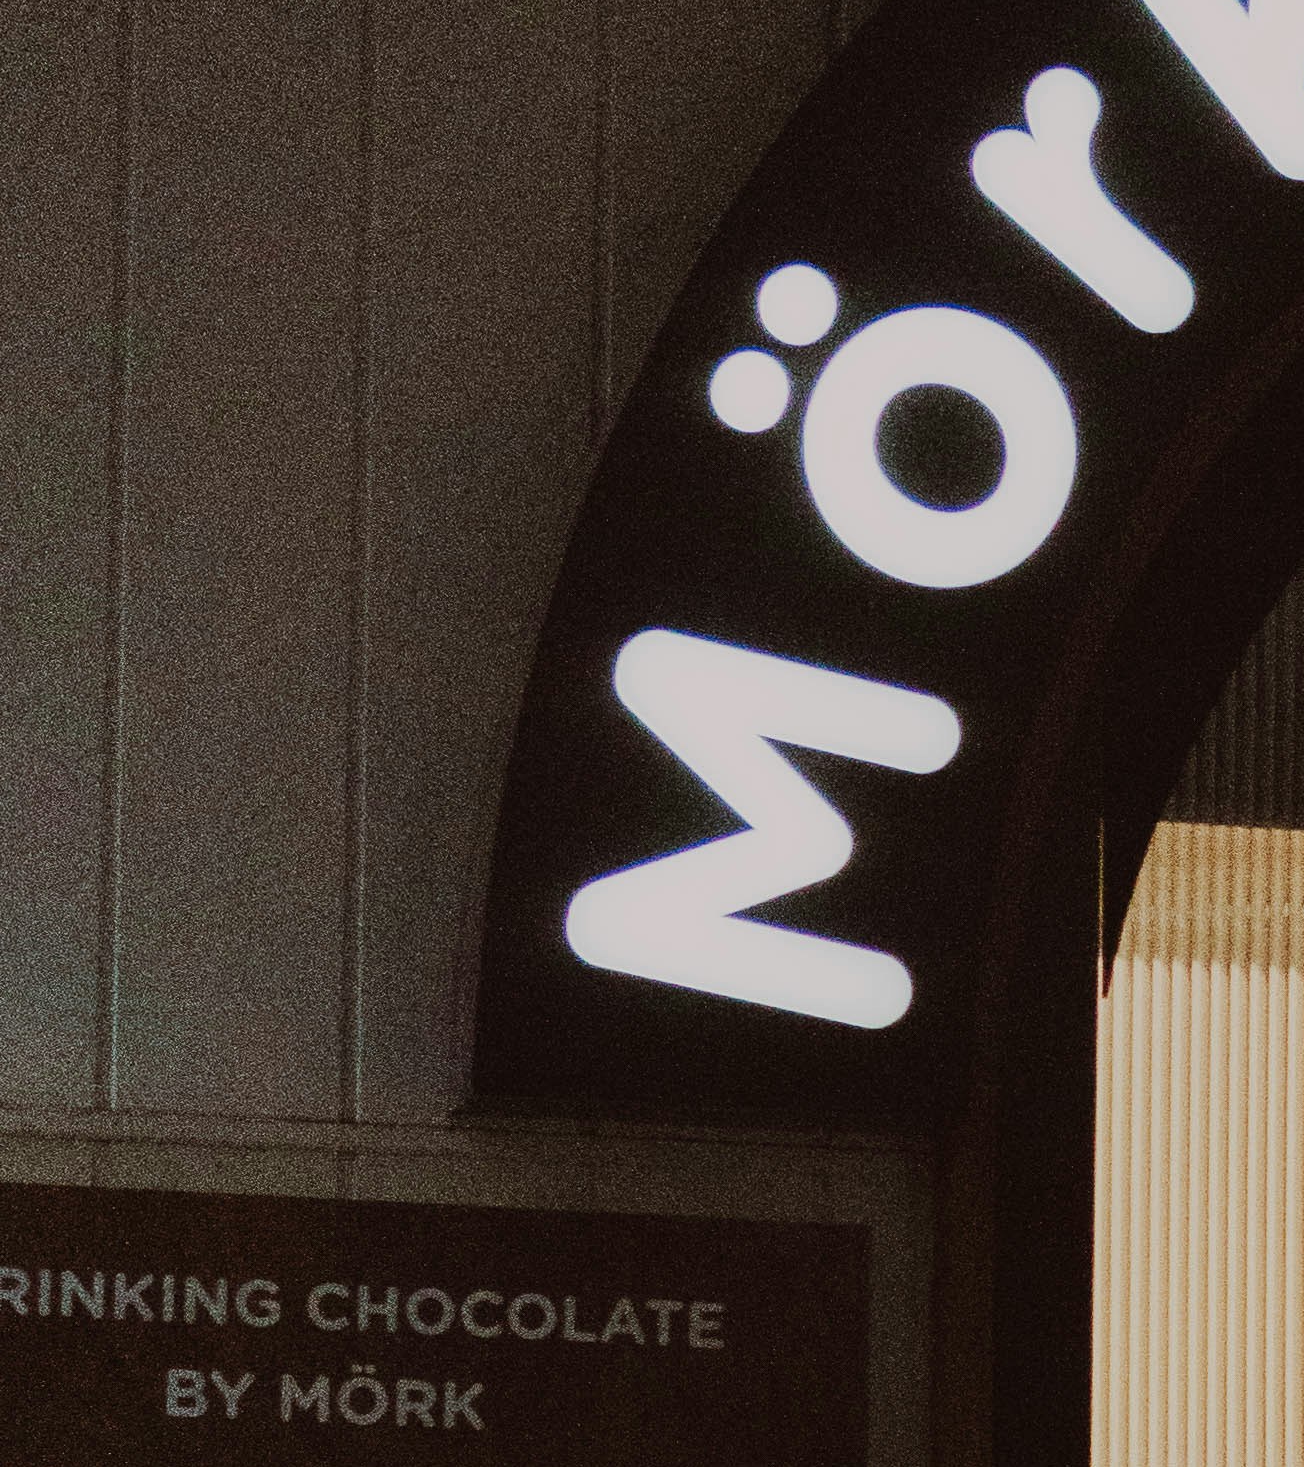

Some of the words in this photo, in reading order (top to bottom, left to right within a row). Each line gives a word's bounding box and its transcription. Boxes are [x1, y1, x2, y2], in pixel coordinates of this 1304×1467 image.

[307, 1282, 725, 1349] CHOCOLATE
[165, 1368, 255, 1420] BY
[280, 1363, 484, 1431] MÖRK
